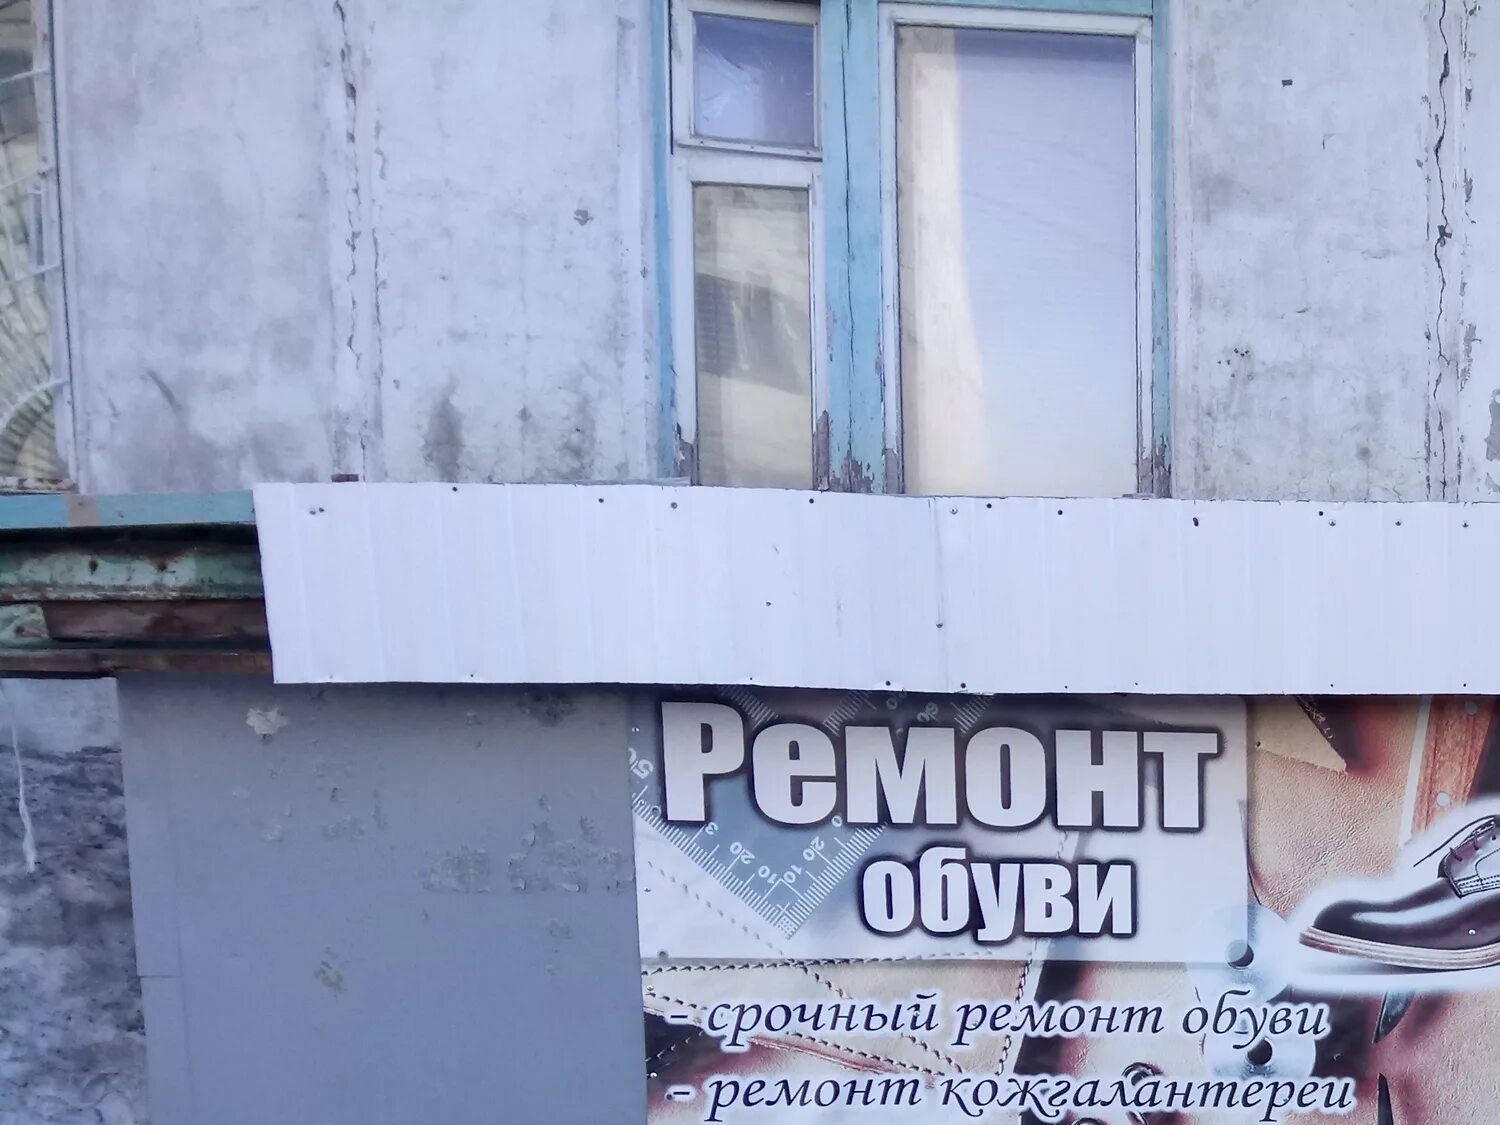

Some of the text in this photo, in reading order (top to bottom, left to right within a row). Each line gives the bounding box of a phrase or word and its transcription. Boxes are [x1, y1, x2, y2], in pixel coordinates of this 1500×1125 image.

[660, 701, 1219, 829] Ремонт
[861, 846, 1135, 943] обуви
[707, 993, 939, 1047] срочный
[953, 1003, 1163, 1046] ремонт
[1182, 990, 1325, 1049] обуви
[706, 1078, 922, 1122] ремонт
[941, 1076, 1352, 1122] кожгалантереи
